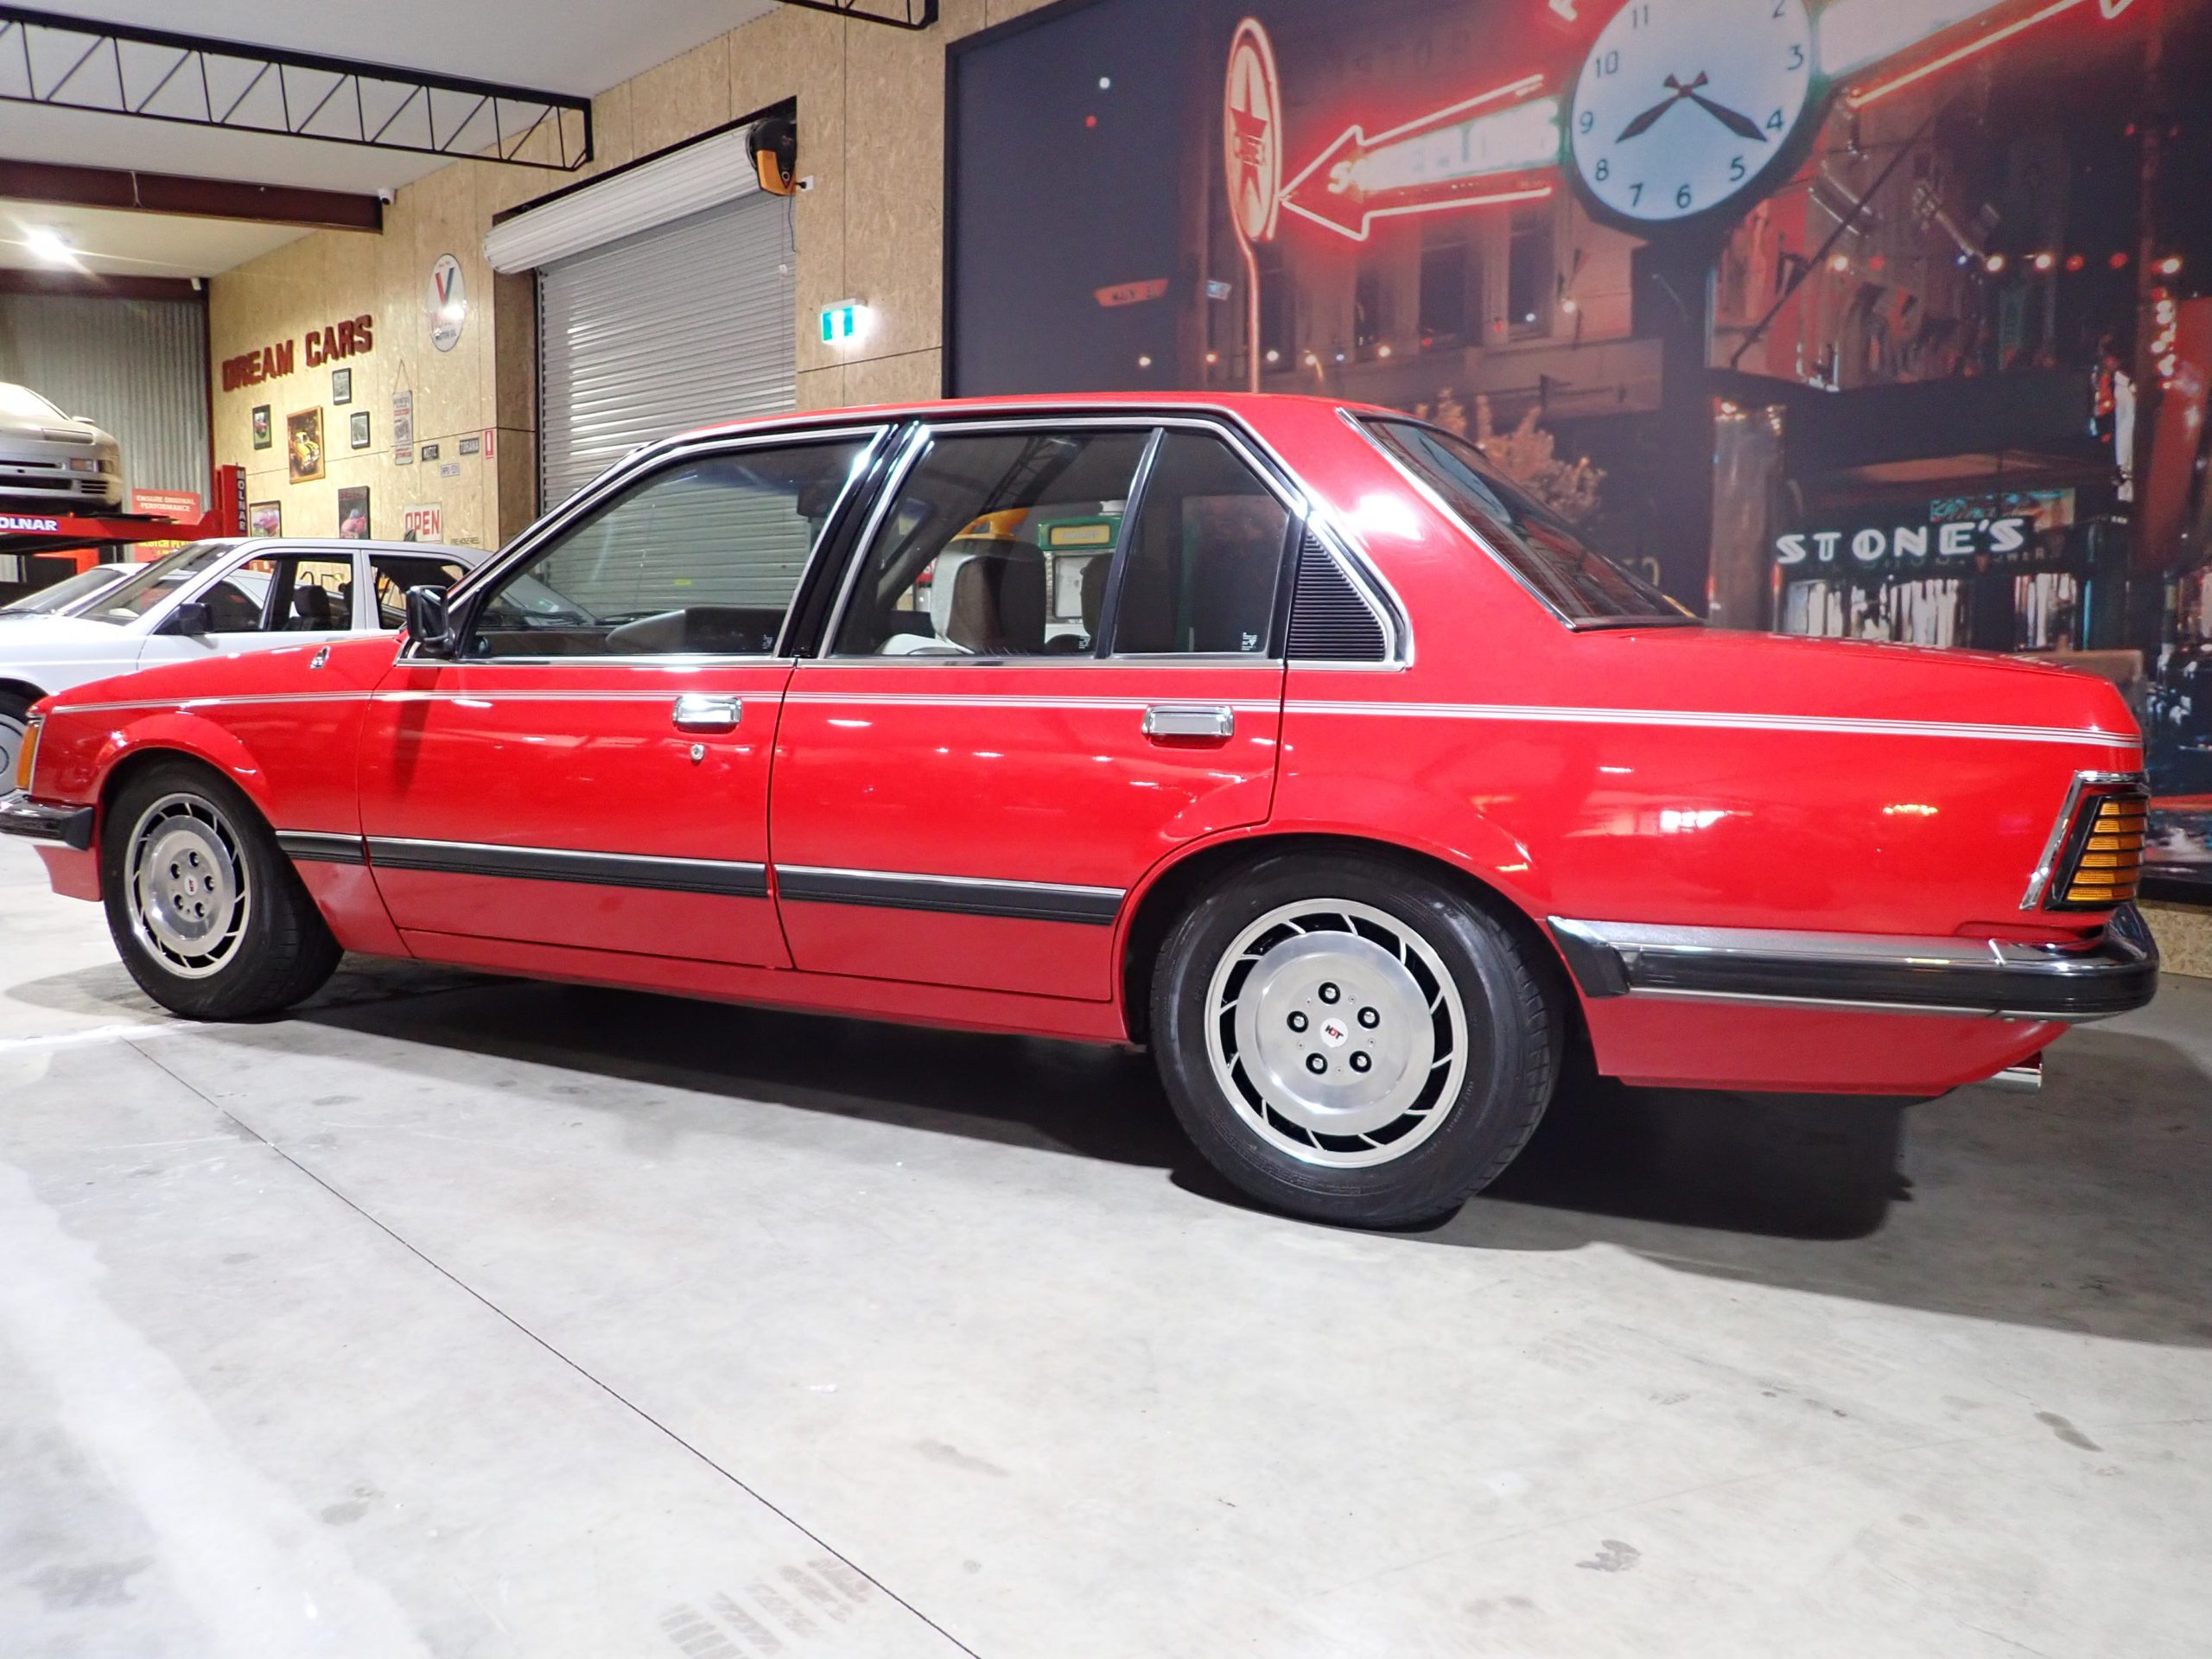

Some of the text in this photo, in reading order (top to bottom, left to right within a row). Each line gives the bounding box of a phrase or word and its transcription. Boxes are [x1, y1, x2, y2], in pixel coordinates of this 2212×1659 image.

[1632, 6, 1649, 29] 11
[1773, 0, 1785, 18] 2
[1595, 50, 1618, 78] 10
[1787, 45, 1804, 71] 3
[1580, 111, 1593, 134] 9
[1767, 108, 1783, 130] 4
[1595, 158, 1609, 181] 8
[1730, 156, 1745, 182] 5
[1630, 182, 1643, 207] 7
[1676, 184, 1692, 208] 6
[222, 315, 373, 392] DREAM CARS
[405, 510, 440, 535] OPEN
[1776, 518, 2025, 565] STONE'S
